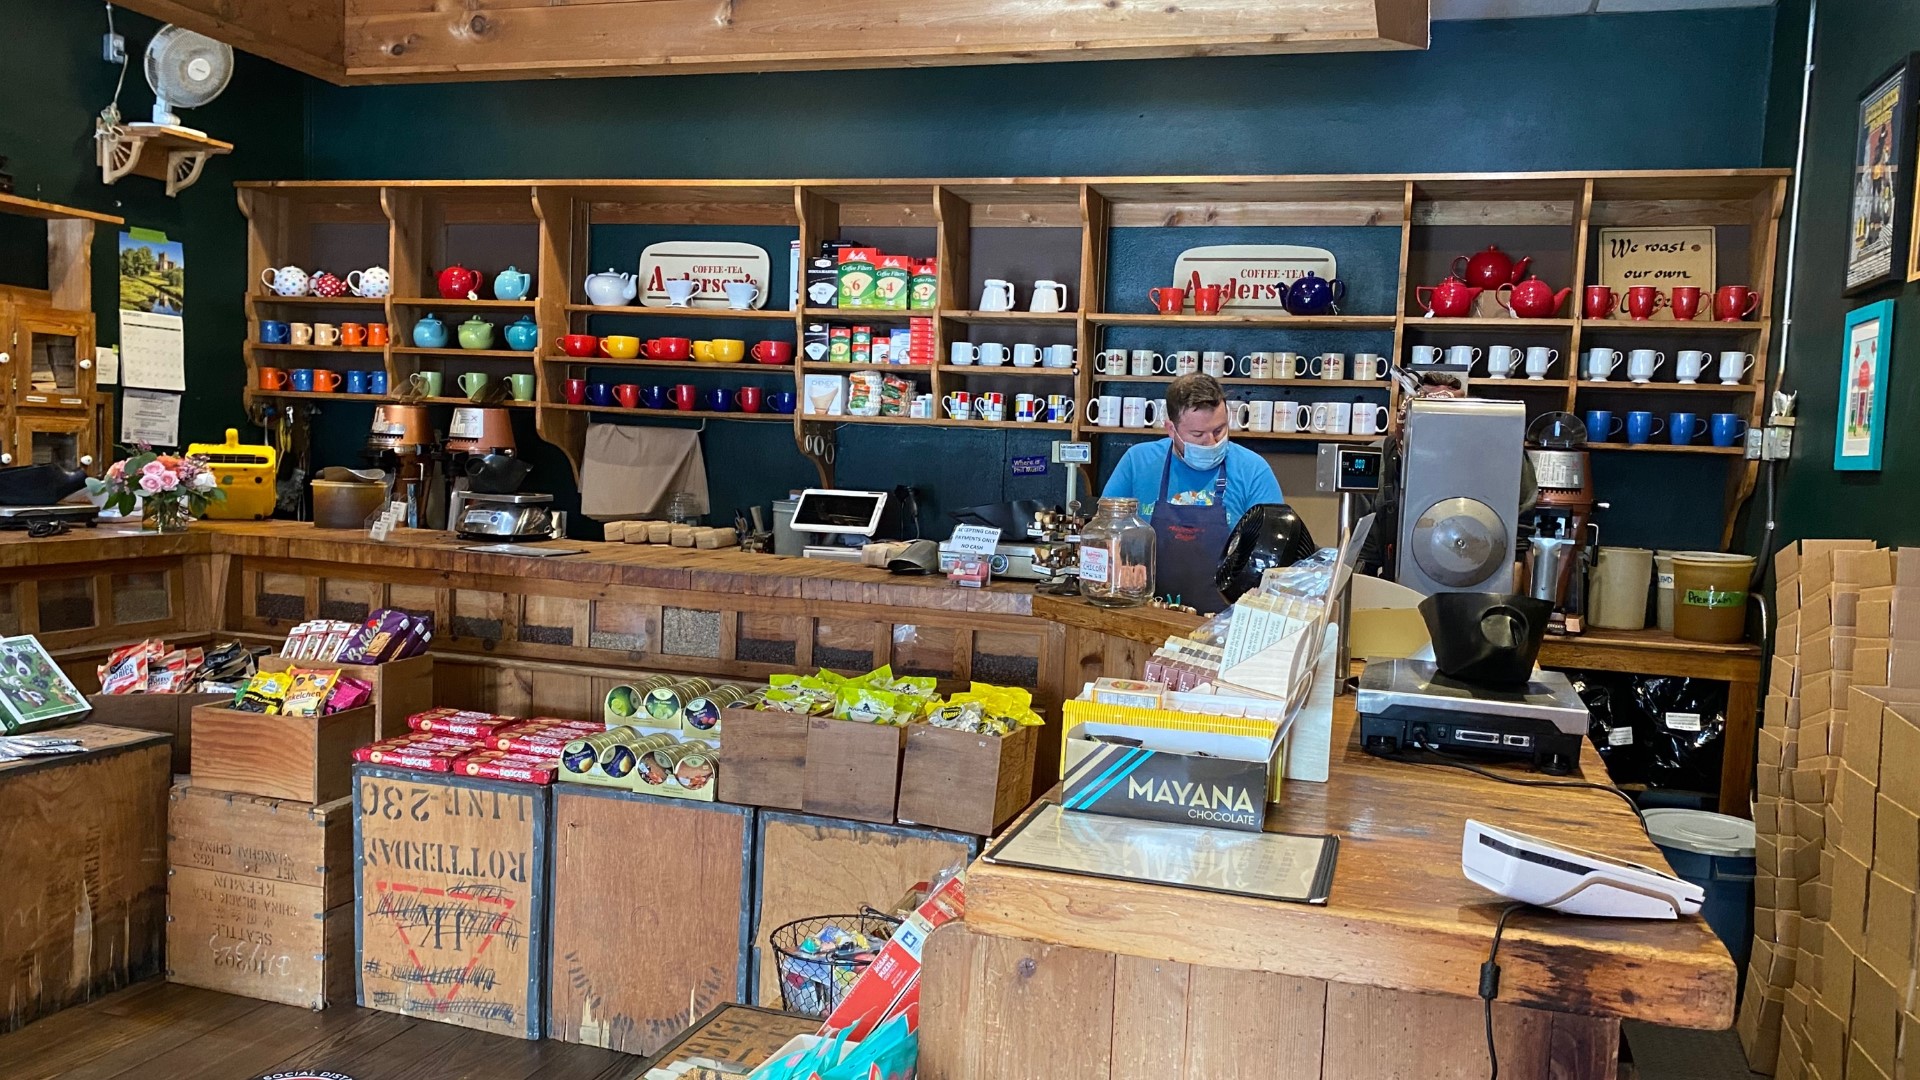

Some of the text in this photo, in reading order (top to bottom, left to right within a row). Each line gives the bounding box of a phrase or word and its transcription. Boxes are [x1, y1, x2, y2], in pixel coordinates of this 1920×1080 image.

[1611, 239, 1685, 258] We roast
[1624, 269, 1692, 279] our own
[852, 279, 861, 291] 6
[886, 282, 894, 293] 4
[922, 286, 928, 296] 2
[1687, 590, 1733, 605] Premum
[1128, 775, 1255, 813] MAYANA
[1187, 808, 1255, 826] CHOCOLATE
[214, 875, 275, 897] KEEMUN
[220, 893, 257, 910] BLACK
[264, 900, 296, 916] CHINA
[212, 922, 272, 945] SEATTLE
[263, 1071, 316, 1080] SOCIAL
